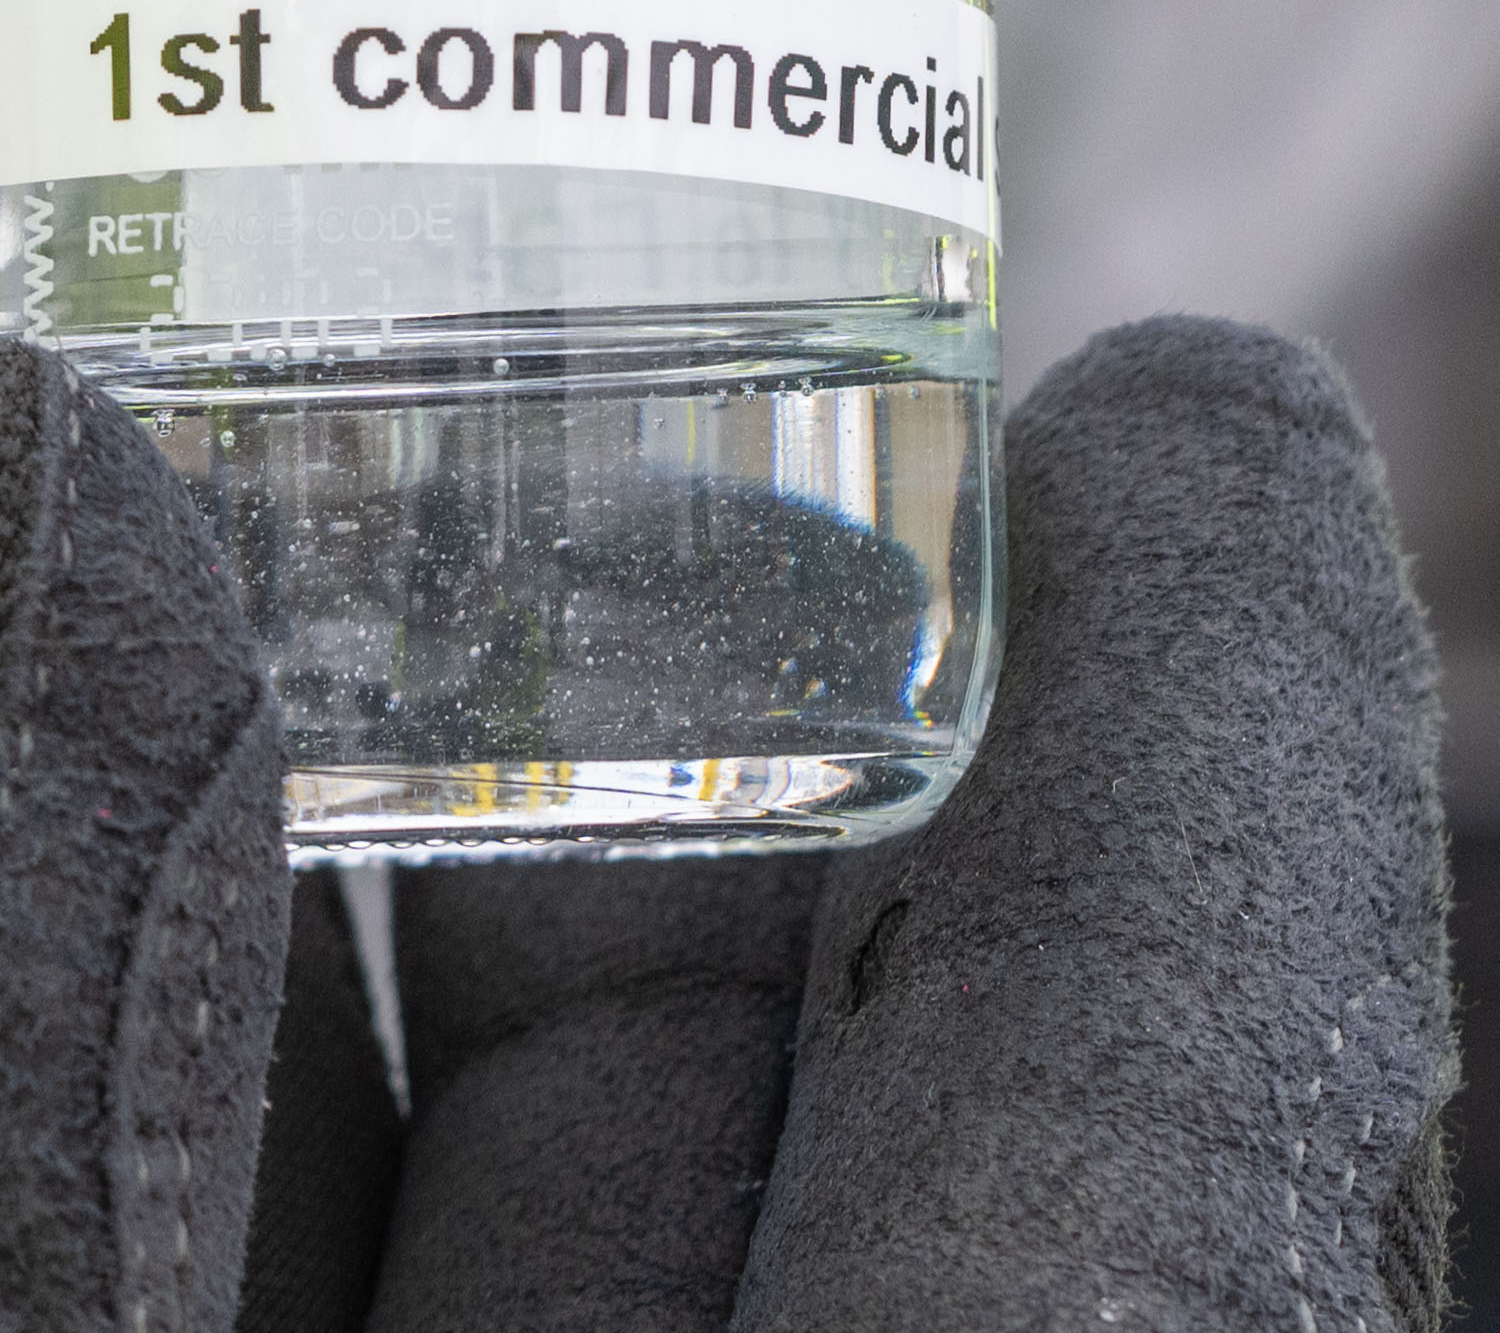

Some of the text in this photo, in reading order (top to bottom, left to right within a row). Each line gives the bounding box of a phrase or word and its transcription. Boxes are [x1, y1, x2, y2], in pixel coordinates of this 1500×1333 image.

[90, 9, 274, 120] 1st
[333, 27, 984, 183] commercial
[87, 203, 455, 257] RETRACE CODE
